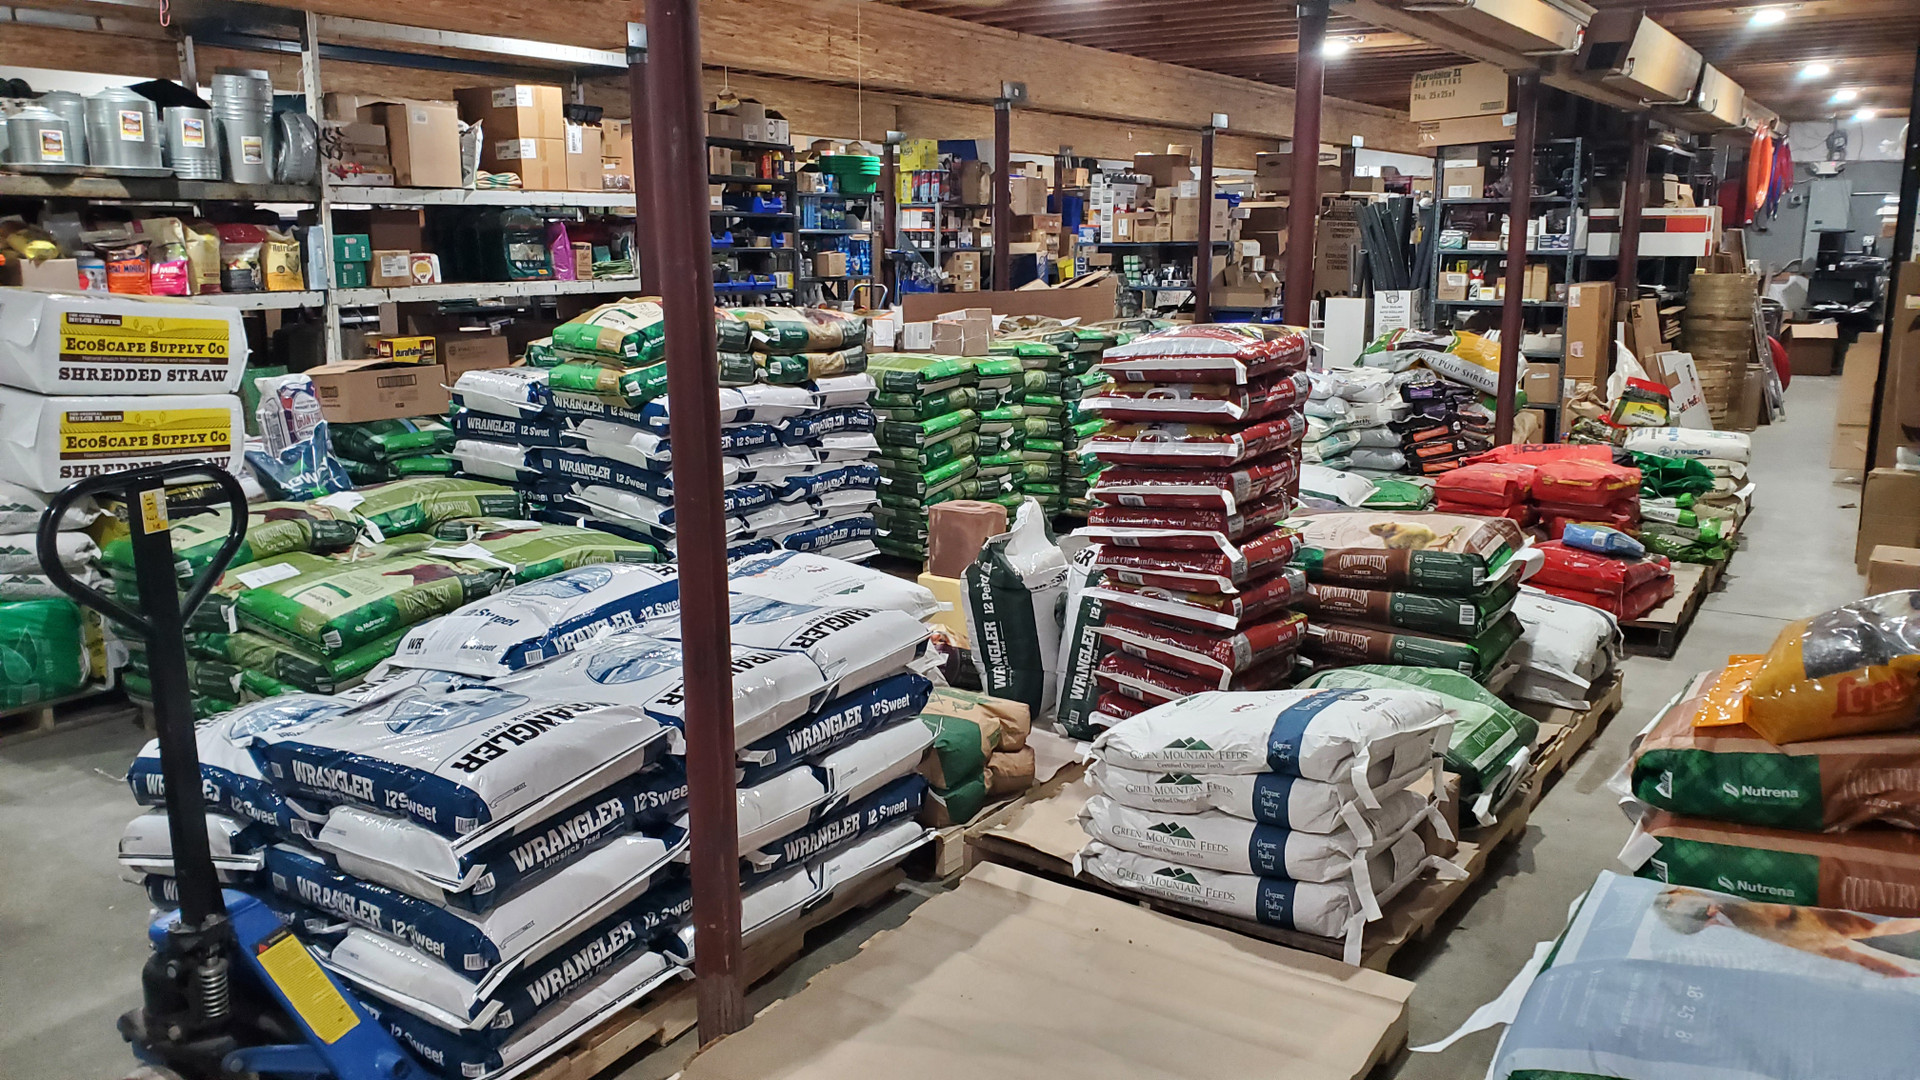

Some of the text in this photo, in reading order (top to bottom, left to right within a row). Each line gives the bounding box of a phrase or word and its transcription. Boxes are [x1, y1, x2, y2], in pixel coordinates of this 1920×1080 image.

[150, 341, 205, 354] SUPPLY
[59, 367, 228, 382] SHREDDED STRAW
[1438, 356, 1460, 373] PULP
[1462, 368, 1495, 388] SHREDS
[552, 395, 641, 422] WRANGLER 12 Sweet
[467, 417, 550, 437] WRANGLER 12 Sweet
[152, 432, 207, 445] SUPPLY
[736, 437, 744, 447] 12
[744, 435, 765, 446] Sweet
[559, 458, 648, 491] WRANGLER 12 Sweet
[746, 494, 766, 506] Sweet
[1167, 517, 1186, 527] Seed
[1097, 555, 1119, 564] Black
[1339, 554, 1390, 574] COUNTRY FEEDS
[1320, 585, 1371, 607] COUNTRY FEEDS
[655, 597, 680, 614] Swee
[983, 602, 995, 615] 12
[1349, 631, 1372, 654] FEEDS
[983, 619, 1006, 690] WRANGLER
[1070, 606, 1101, 701] WRANGLER 12
[787, 693, 911, 755] WRANGLER 12 Sweet
[1163, 750, 1216, 760] MOUNTAIN
[1217, 750, 1248, 761] FEEDS
[292, 759, 375, 803] WRANGLER
[398, 792, 438, 824] Sweet
[1261, 786, 1281, 798] Organic
[1742, 785, 1799, 799] Nutrena
[1261, 798, 1279, 810] Poultry
[509, 784, 689, 874] WRANGLER 12 Swee
[783, 797, 909, 863] WRANGLER 12 Sweet
[1111, 824, 1229, 853] GREEN MOUNTAIN FEEDS
[1257, 839, 1277, 850] Organic
[1257, 849, 1275, 862] Poultry
[1116, 867, 1236, 901] GREEN MOUNTAIN FEEDS
[1737, 880, 1796, 898] Nutrena
[1265, 888, 1285, 900] Organic
[1265, 899, 1284, 912] Poultry
[297, 875, 383, 930] WRANGLER
[391, 918, 409, 940] 12
[409, 924, 446, 960] Sweet
[526, 911, 660, 1007] WRANGLER 12
[390, 1023, 403, 1039] 12
